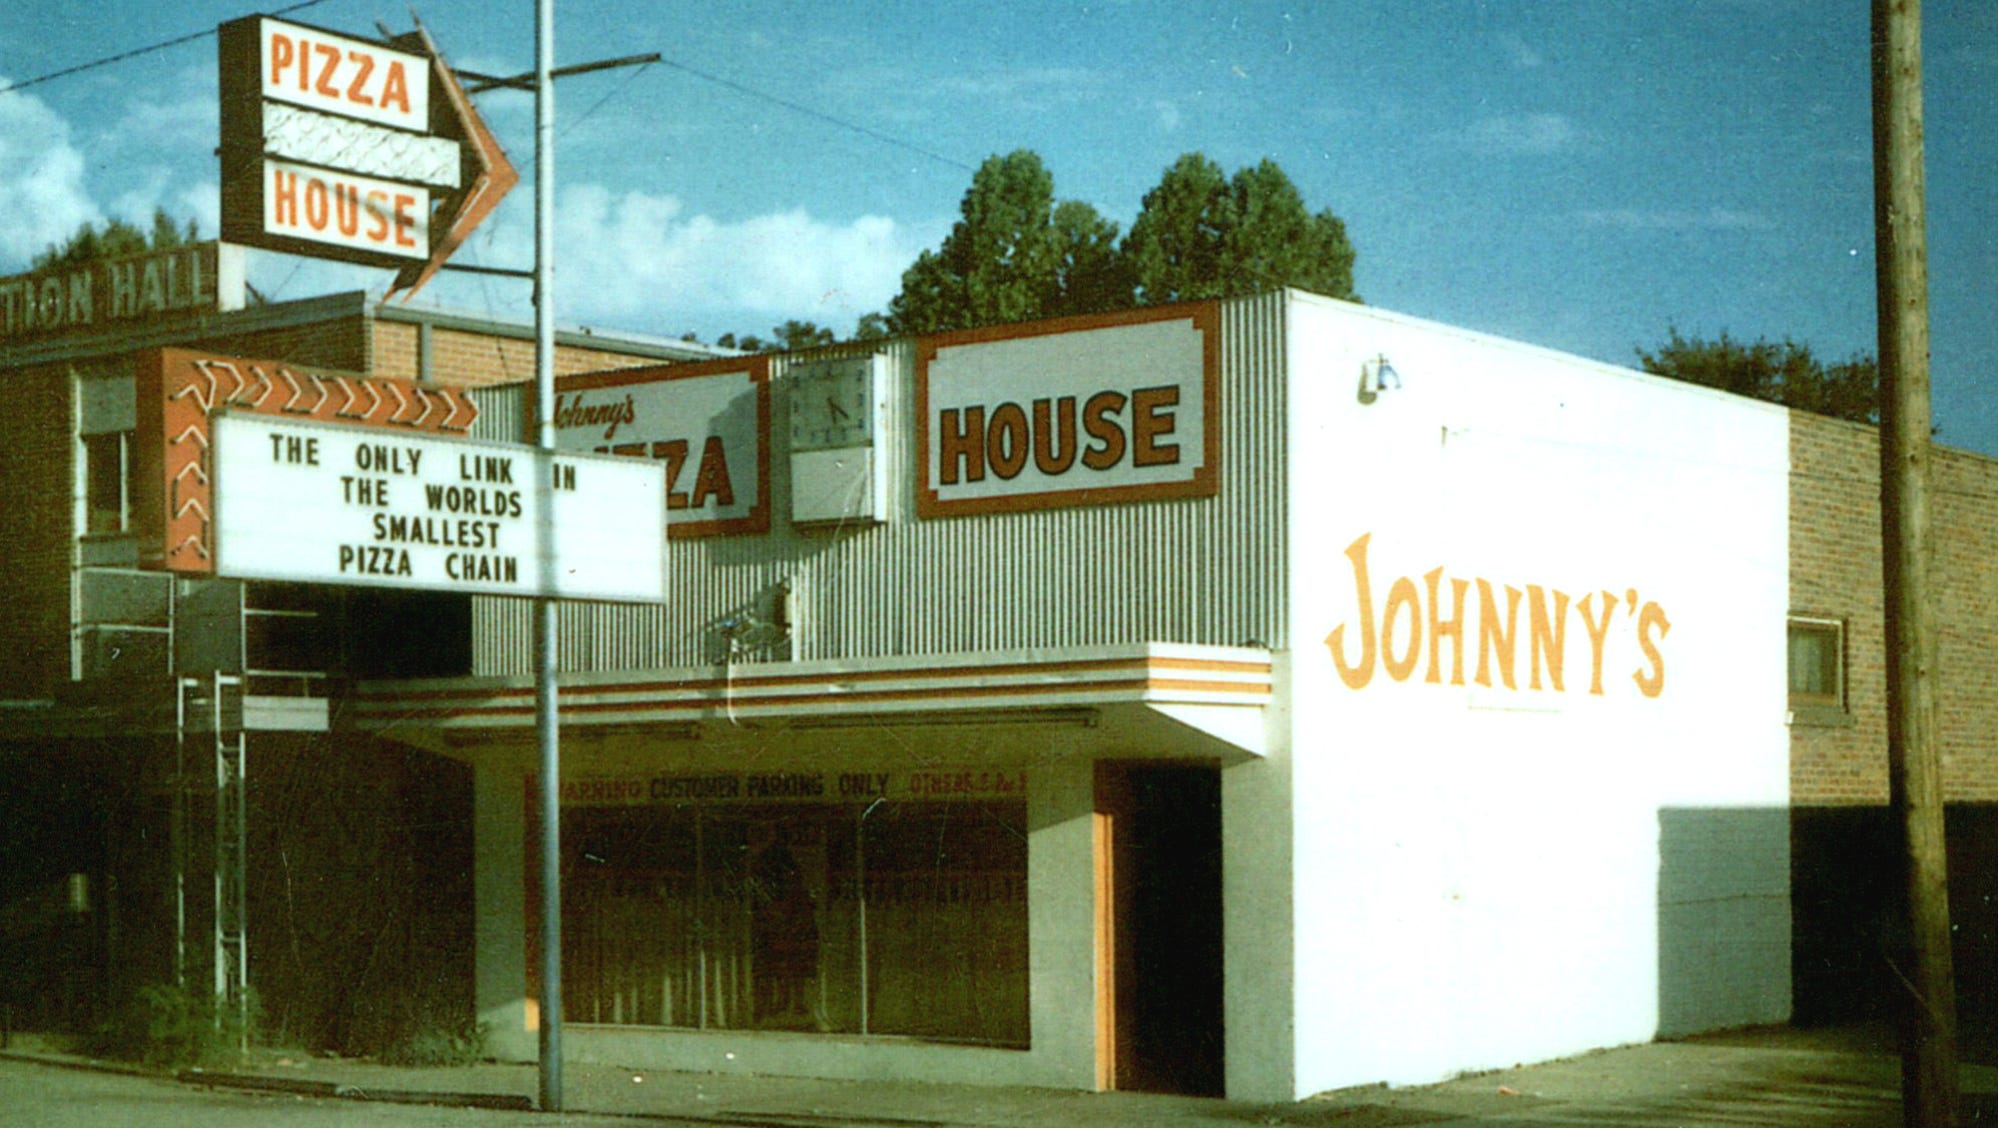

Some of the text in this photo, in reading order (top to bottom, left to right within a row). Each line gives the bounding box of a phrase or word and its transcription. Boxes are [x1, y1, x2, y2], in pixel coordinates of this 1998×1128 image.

[271, 33, 410, 113] PIZZA
[275, 169, 416, 247] HOUSE
[109, 251, 214, 317] HALL
[269, 434, 576, 491] THE ONLY LINK IN
[939, 384, 1180, 485] HOUSE
[341, 477, 522, 518] THE WORLDS
[373, 513, 500, 549] SMALLEST
[339, 545, 517, 583] PIZZA CHAIN
[1323, 533, 1672, 699] JOHNNY'S
[559, 779, 642, 801] ARNING
[650, 774, 741, 799] CUSTOMER
[747, 771, 824, 798] PARKING
[838, 772, 890, 796] ONLY
